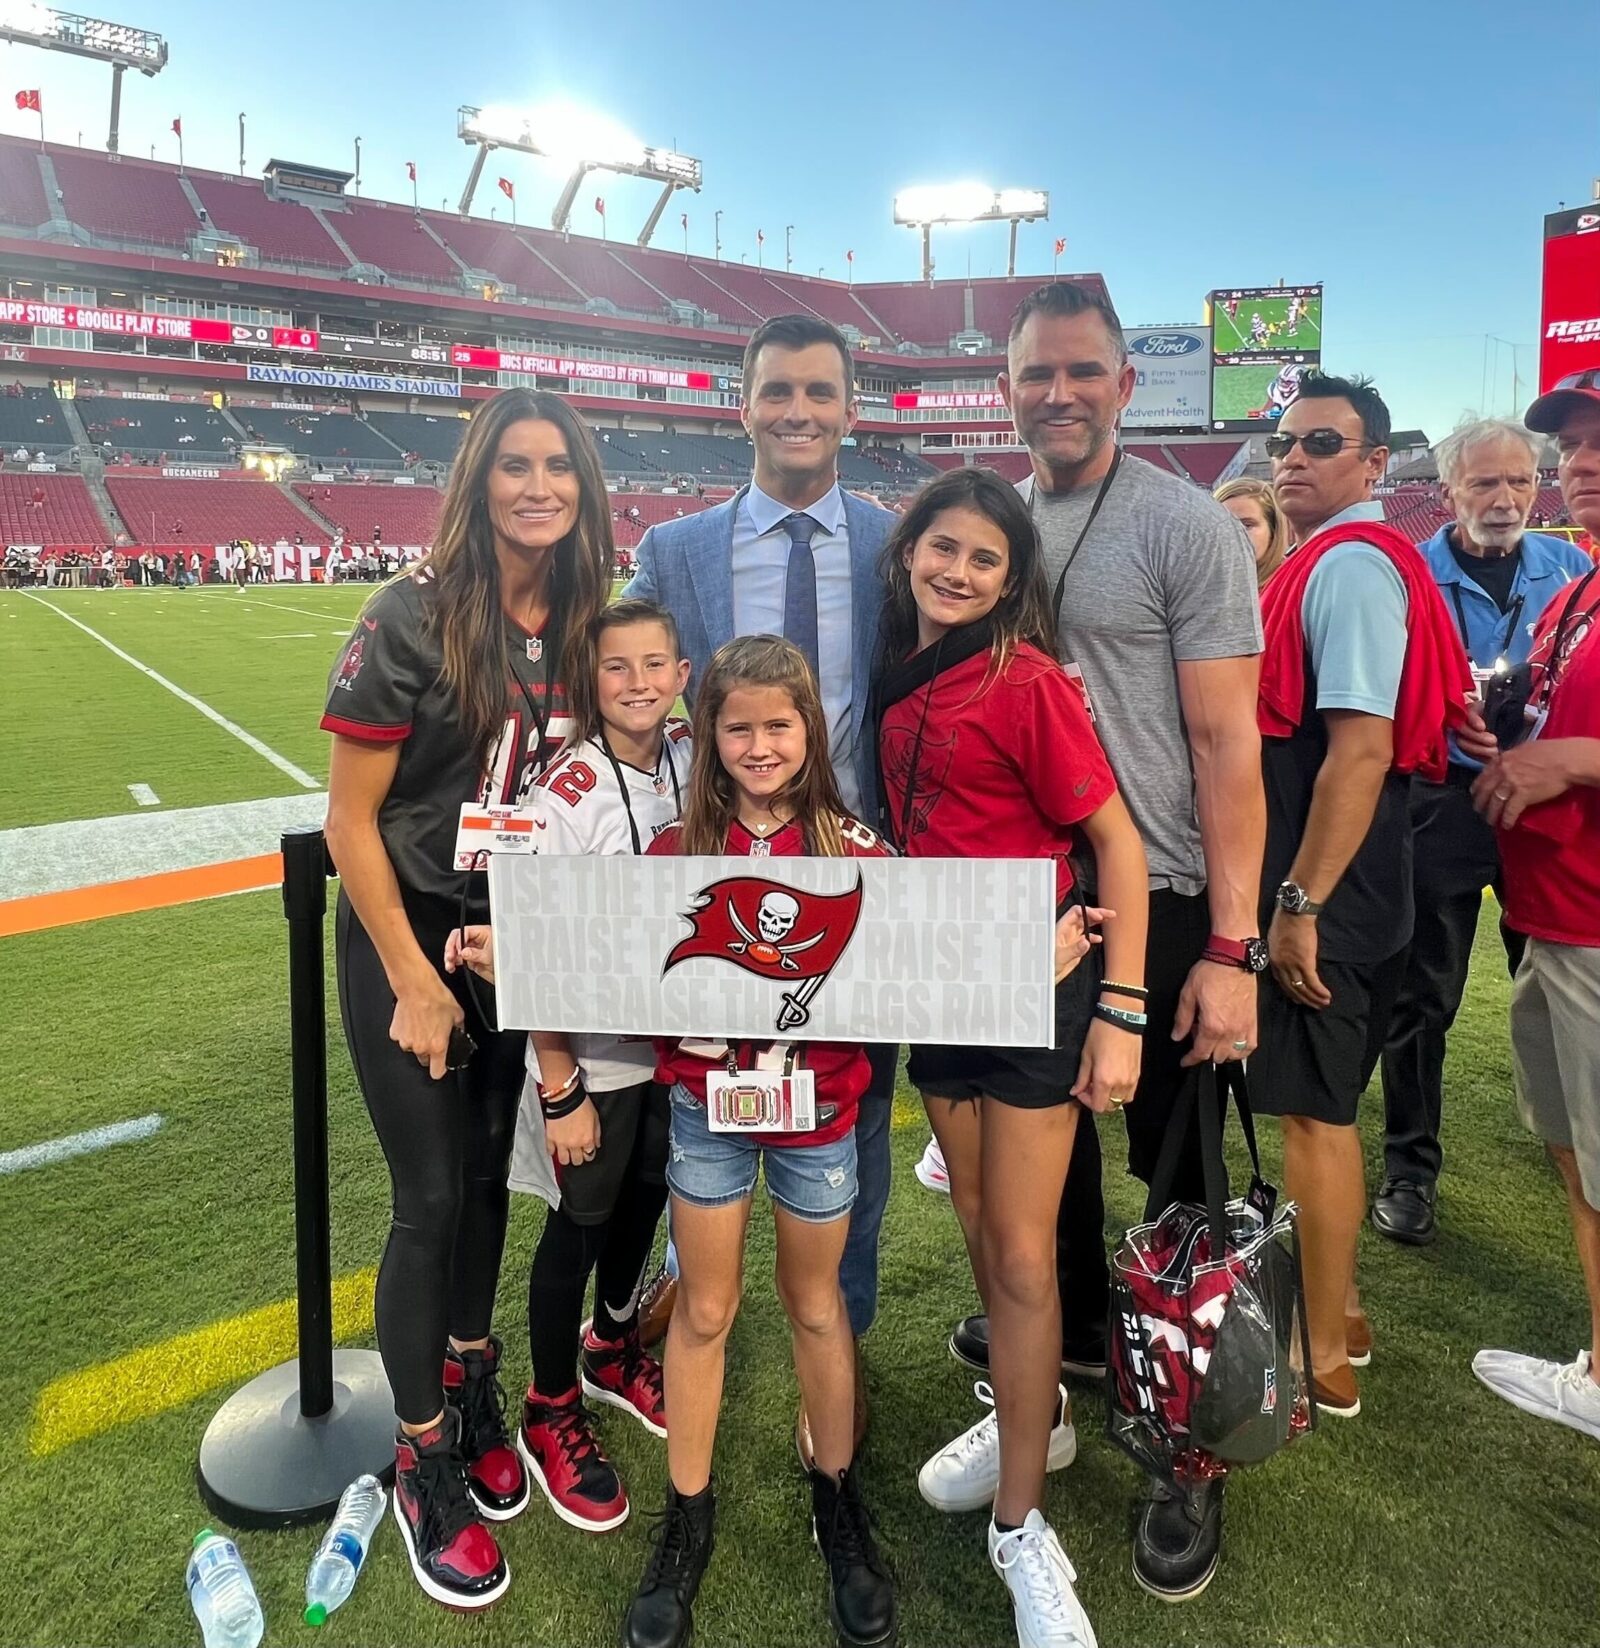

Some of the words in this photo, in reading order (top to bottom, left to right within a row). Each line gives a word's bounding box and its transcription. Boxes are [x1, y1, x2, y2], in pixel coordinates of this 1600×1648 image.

[0, 302, 24, 320] APP
[27, 305, 65, 325] STORE
[77, 310, 123, 331] GOOGLE
[125, 315, 154, 334] PLAY
[156, 320, 191, 337] STORE
[256, 328, 268, 340] 0
[300, 333, 311, 344] 0
[1143, 336, 1189, 353] Ford
[455, 352, 471, 362] 25
[500, 354, 521, 369] BUCS
[523, 357, 557, 372] OFFICIAL
[559, 360, 575, 375] APP
[576, 361, 616, 380] PRESENTED
[617, 366, 627, 380] BY
[628, 368, 648, 383] FIFTH
[648, 370, 669, 385] THIRD
[669, 372, 688, 387] BANK
[250, 366, 336, 387] RAYMOND
[338, 373, 391, 391] JAMES
[395, 380, 459, 397] STADIUM
[979, 394, 994, 406] APP
[162, 468, 219, 478] BUCCANEERS
[569, 857, 642, 916] THE
[921, 860, 994, 920] THE
[519, 916, 633, 974] RAISE
[864, 921, 983, 981] RAISE
[510, 972, 586, 1028] AGS
[595, 974, 709, 1033] RAISE
